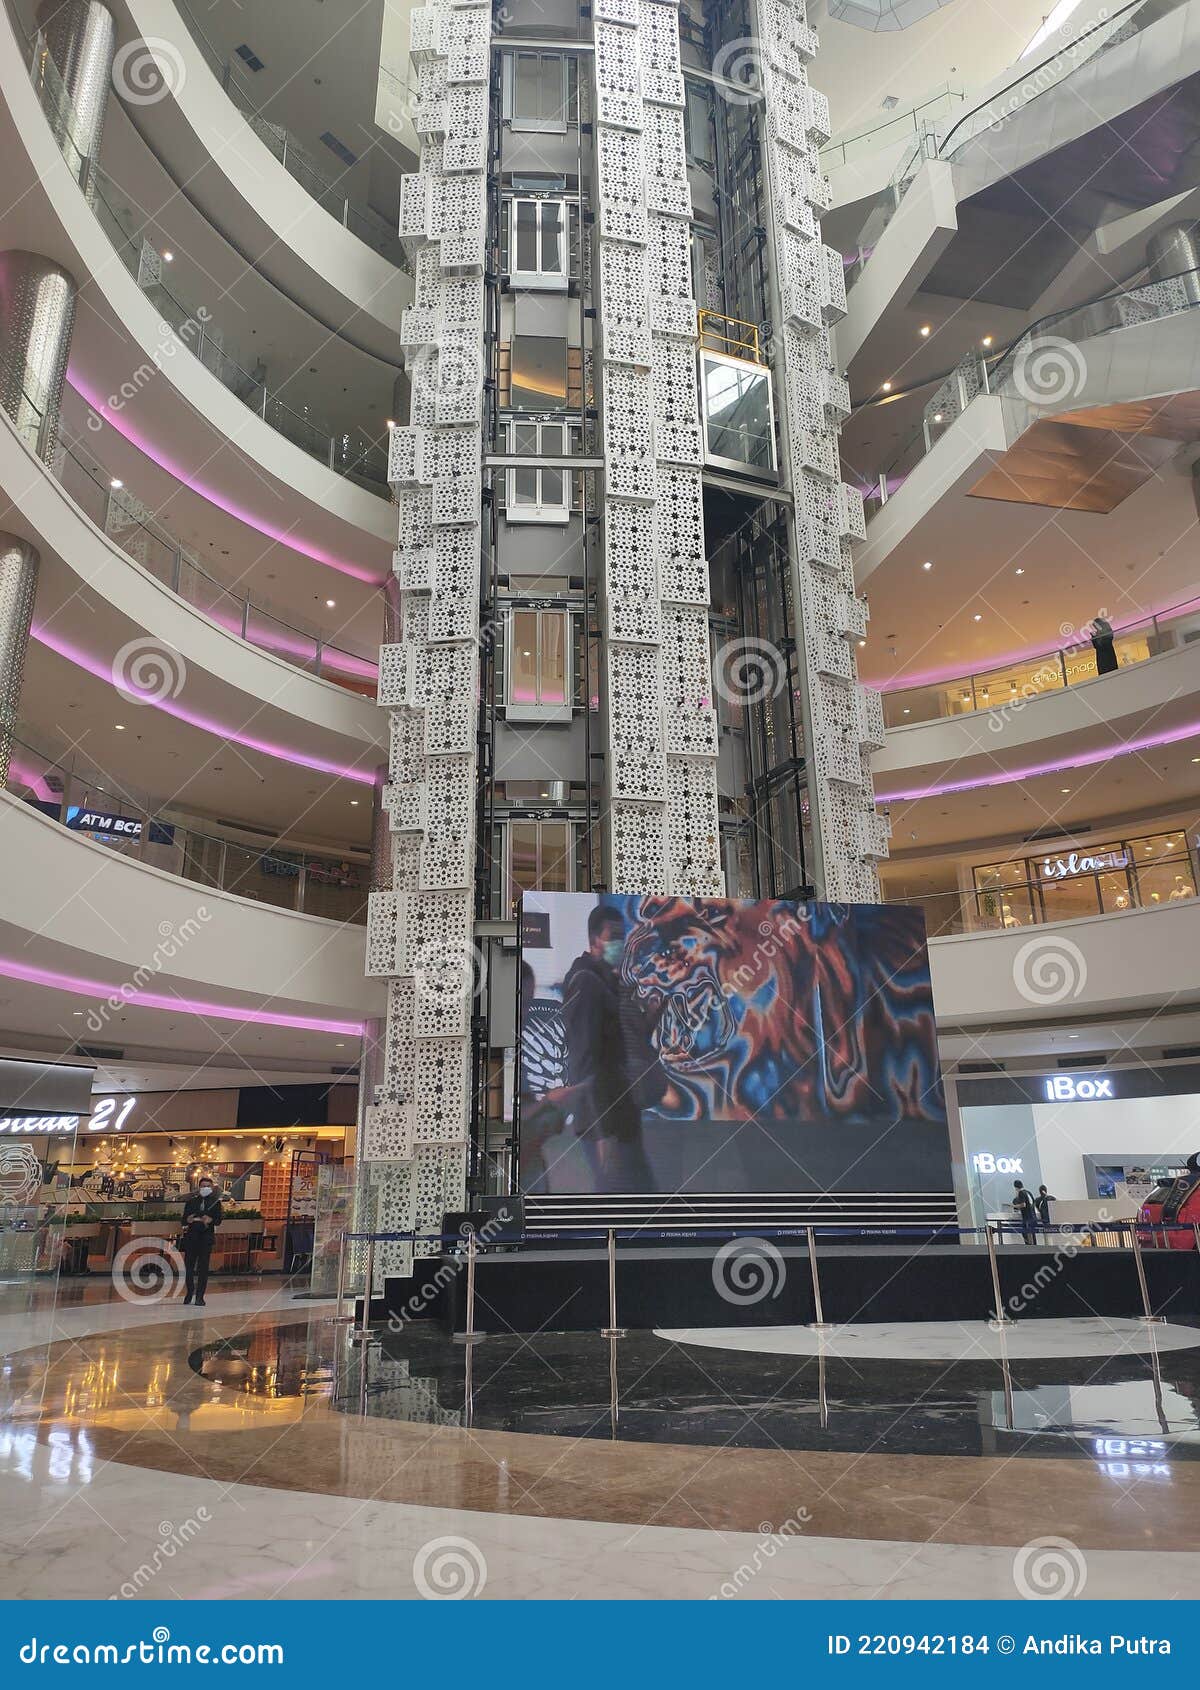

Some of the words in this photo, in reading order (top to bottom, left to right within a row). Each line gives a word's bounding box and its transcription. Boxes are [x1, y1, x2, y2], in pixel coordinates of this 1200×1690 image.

[80, 813, 112, 829] ATM
[1046, 1076, 1112, 1100] iBox
[88, 1098, 136, 1131] 21
[973, 1152, 1024, 1174] iBox
